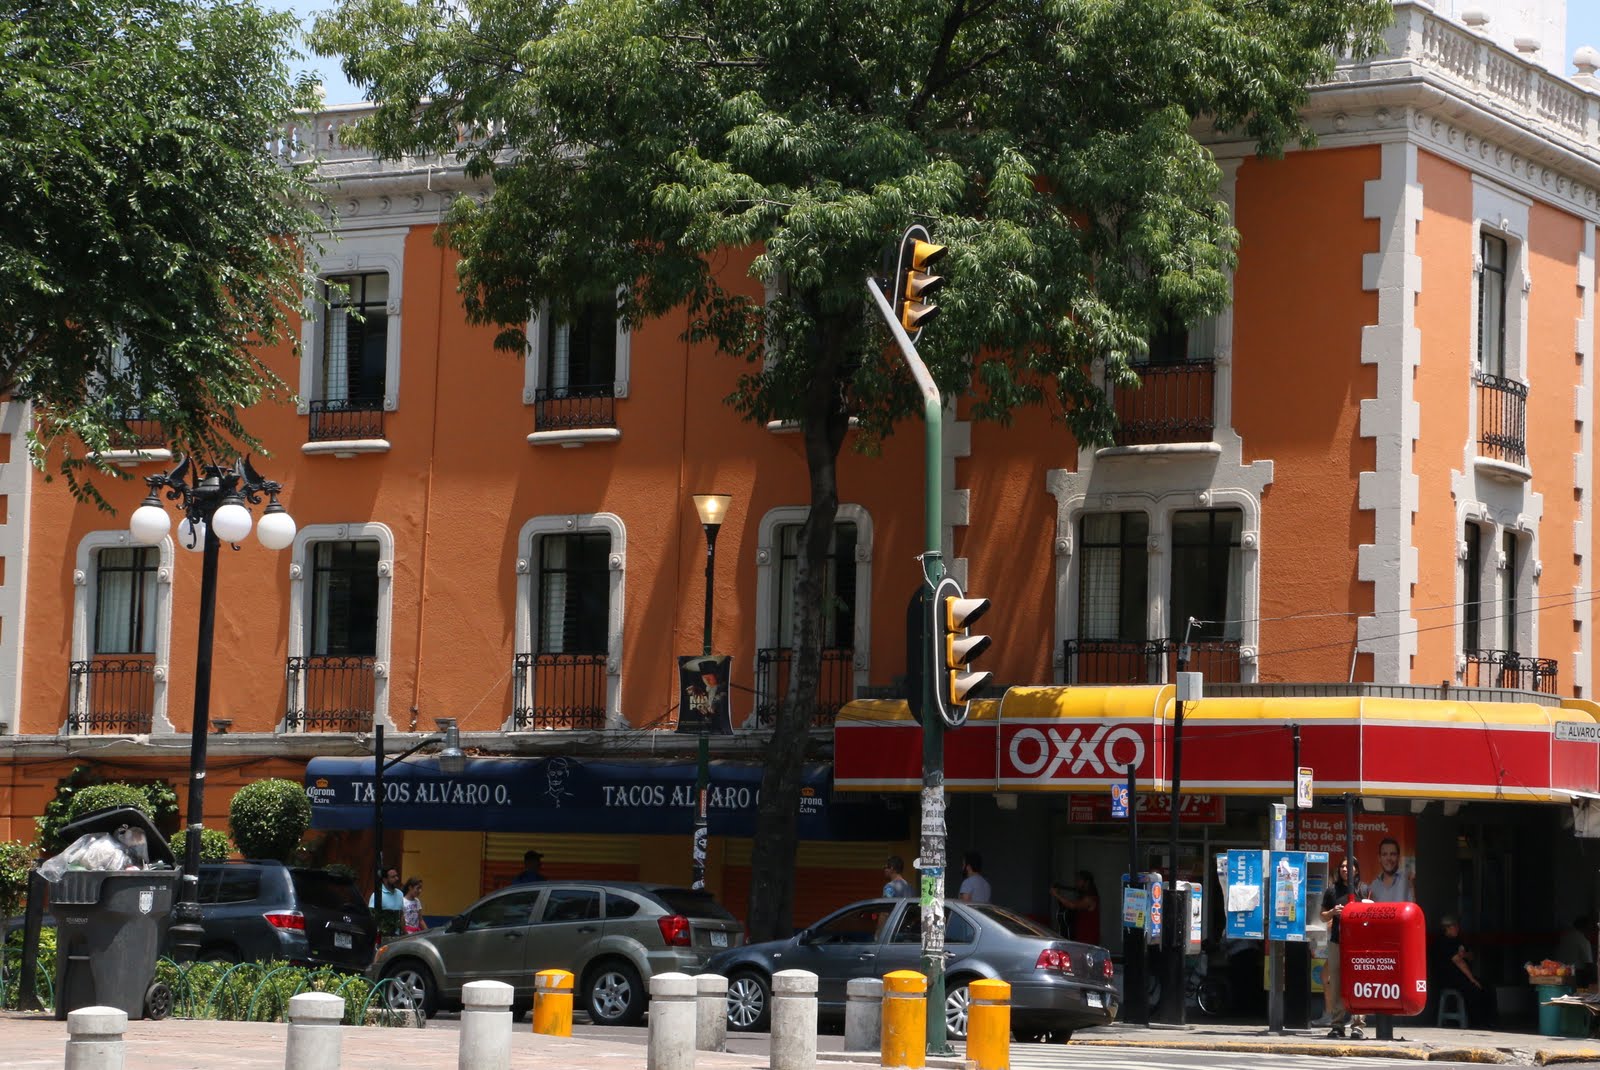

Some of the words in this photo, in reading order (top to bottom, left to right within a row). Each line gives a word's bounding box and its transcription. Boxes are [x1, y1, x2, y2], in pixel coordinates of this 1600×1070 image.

[1568, 726, 1596, 738] ALVARO
[1009, 725, 1145, 777] OXXO
[306, 786, 336, 798] Corona
[415, 780, 490, 804] ALVARO
[603, 786, 665, 806] TACOS
[670, 784, 750, 808] ALARO
[800, 797, 823, 806] orona
[1302, 819, 1311, 829] la
[1313, 820, 1331, 831] luz,
[1333, 820, 1343, 829] el
[1320, 831, 1334, 840] de
[1353, 982, 1400, 999] 06700
